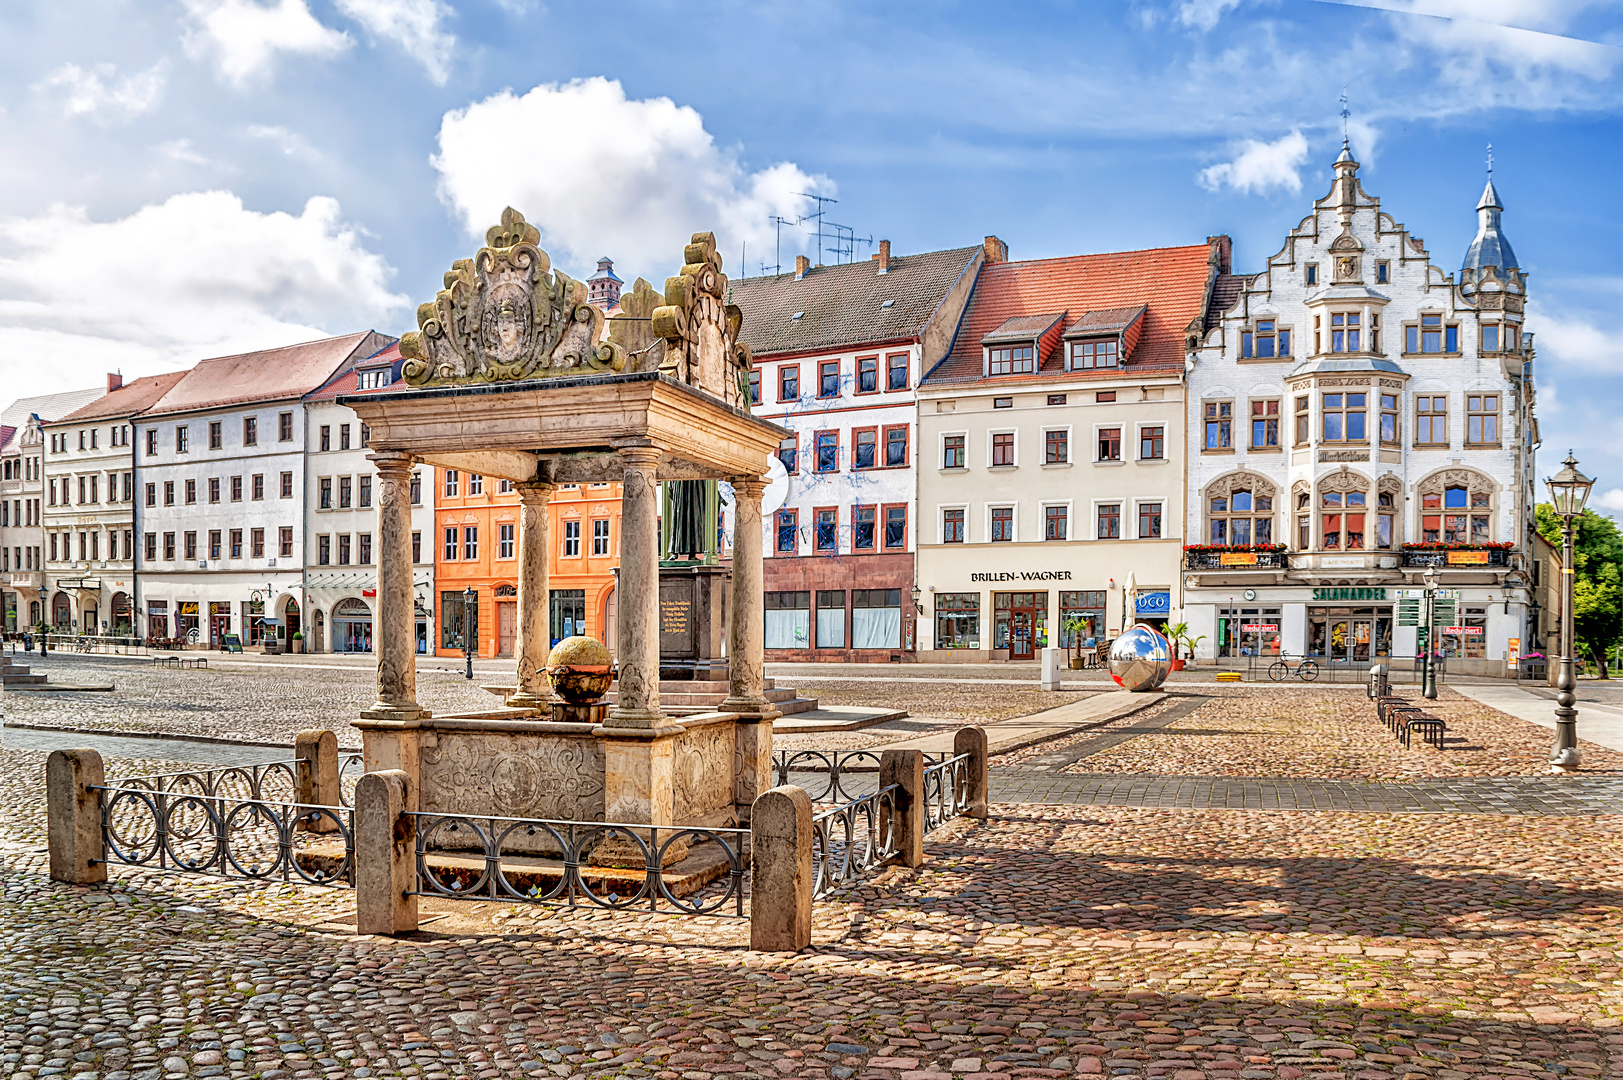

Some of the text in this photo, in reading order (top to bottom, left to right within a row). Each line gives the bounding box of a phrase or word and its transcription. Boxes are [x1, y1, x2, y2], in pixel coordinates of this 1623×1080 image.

[77, 516, 99, 524] HOTEL
[971, 571, 1072, 582] BRILLEN-WAGNER
[1312, 587, 1387, 600] SALAMANDER
[1135, 596, 1165, 608] OCO
